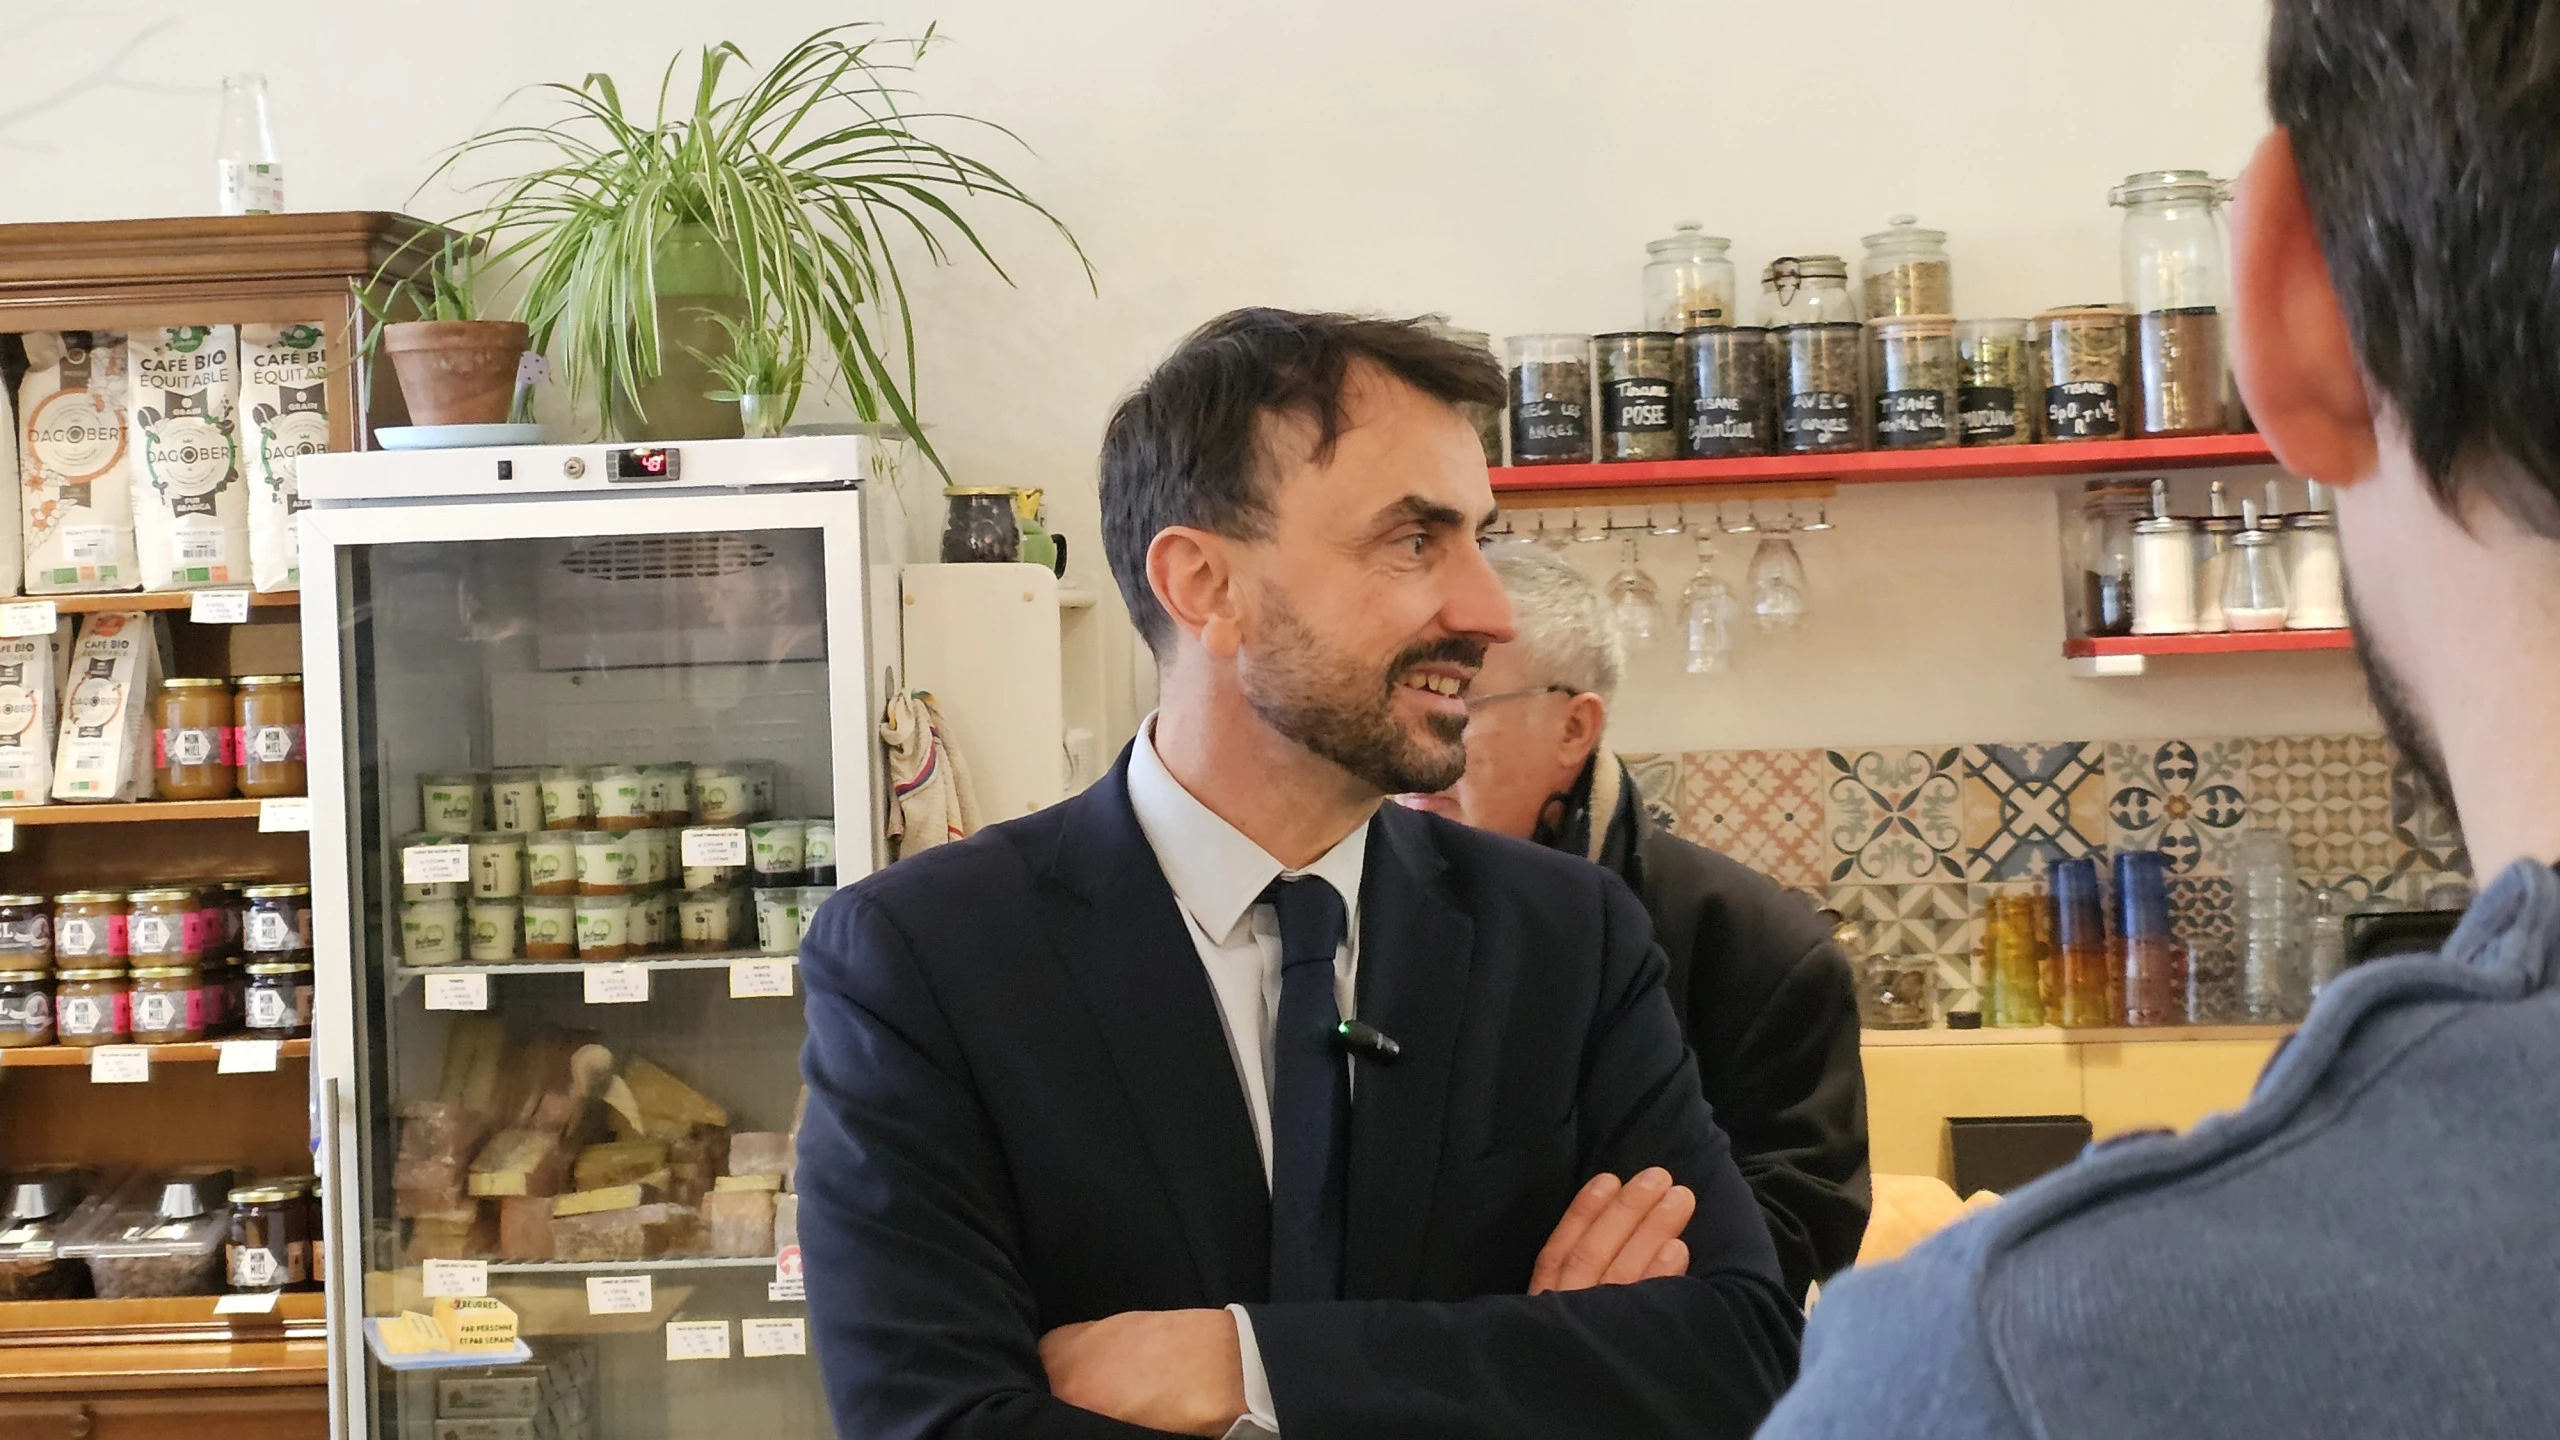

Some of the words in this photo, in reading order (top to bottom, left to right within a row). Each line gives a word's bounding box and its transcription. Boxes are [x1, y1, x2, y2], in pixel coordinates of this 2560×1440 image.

[140, 356, 187, 372] CAFÉ
[195, 350, 226, 370] BIO
[253, 352, 300, 367] CAFÉ
[140, 369, 229, 389] ÉQUITABLE
[1793, 393, 1848, 409] AVEC
[28, 425, 127, 444] DAGOBERT
[147, 445, 237, 464] DAGOBERT
[110, 639, 129, 649] BIO
[476, 1323, 513, 1332] PERSONNE
